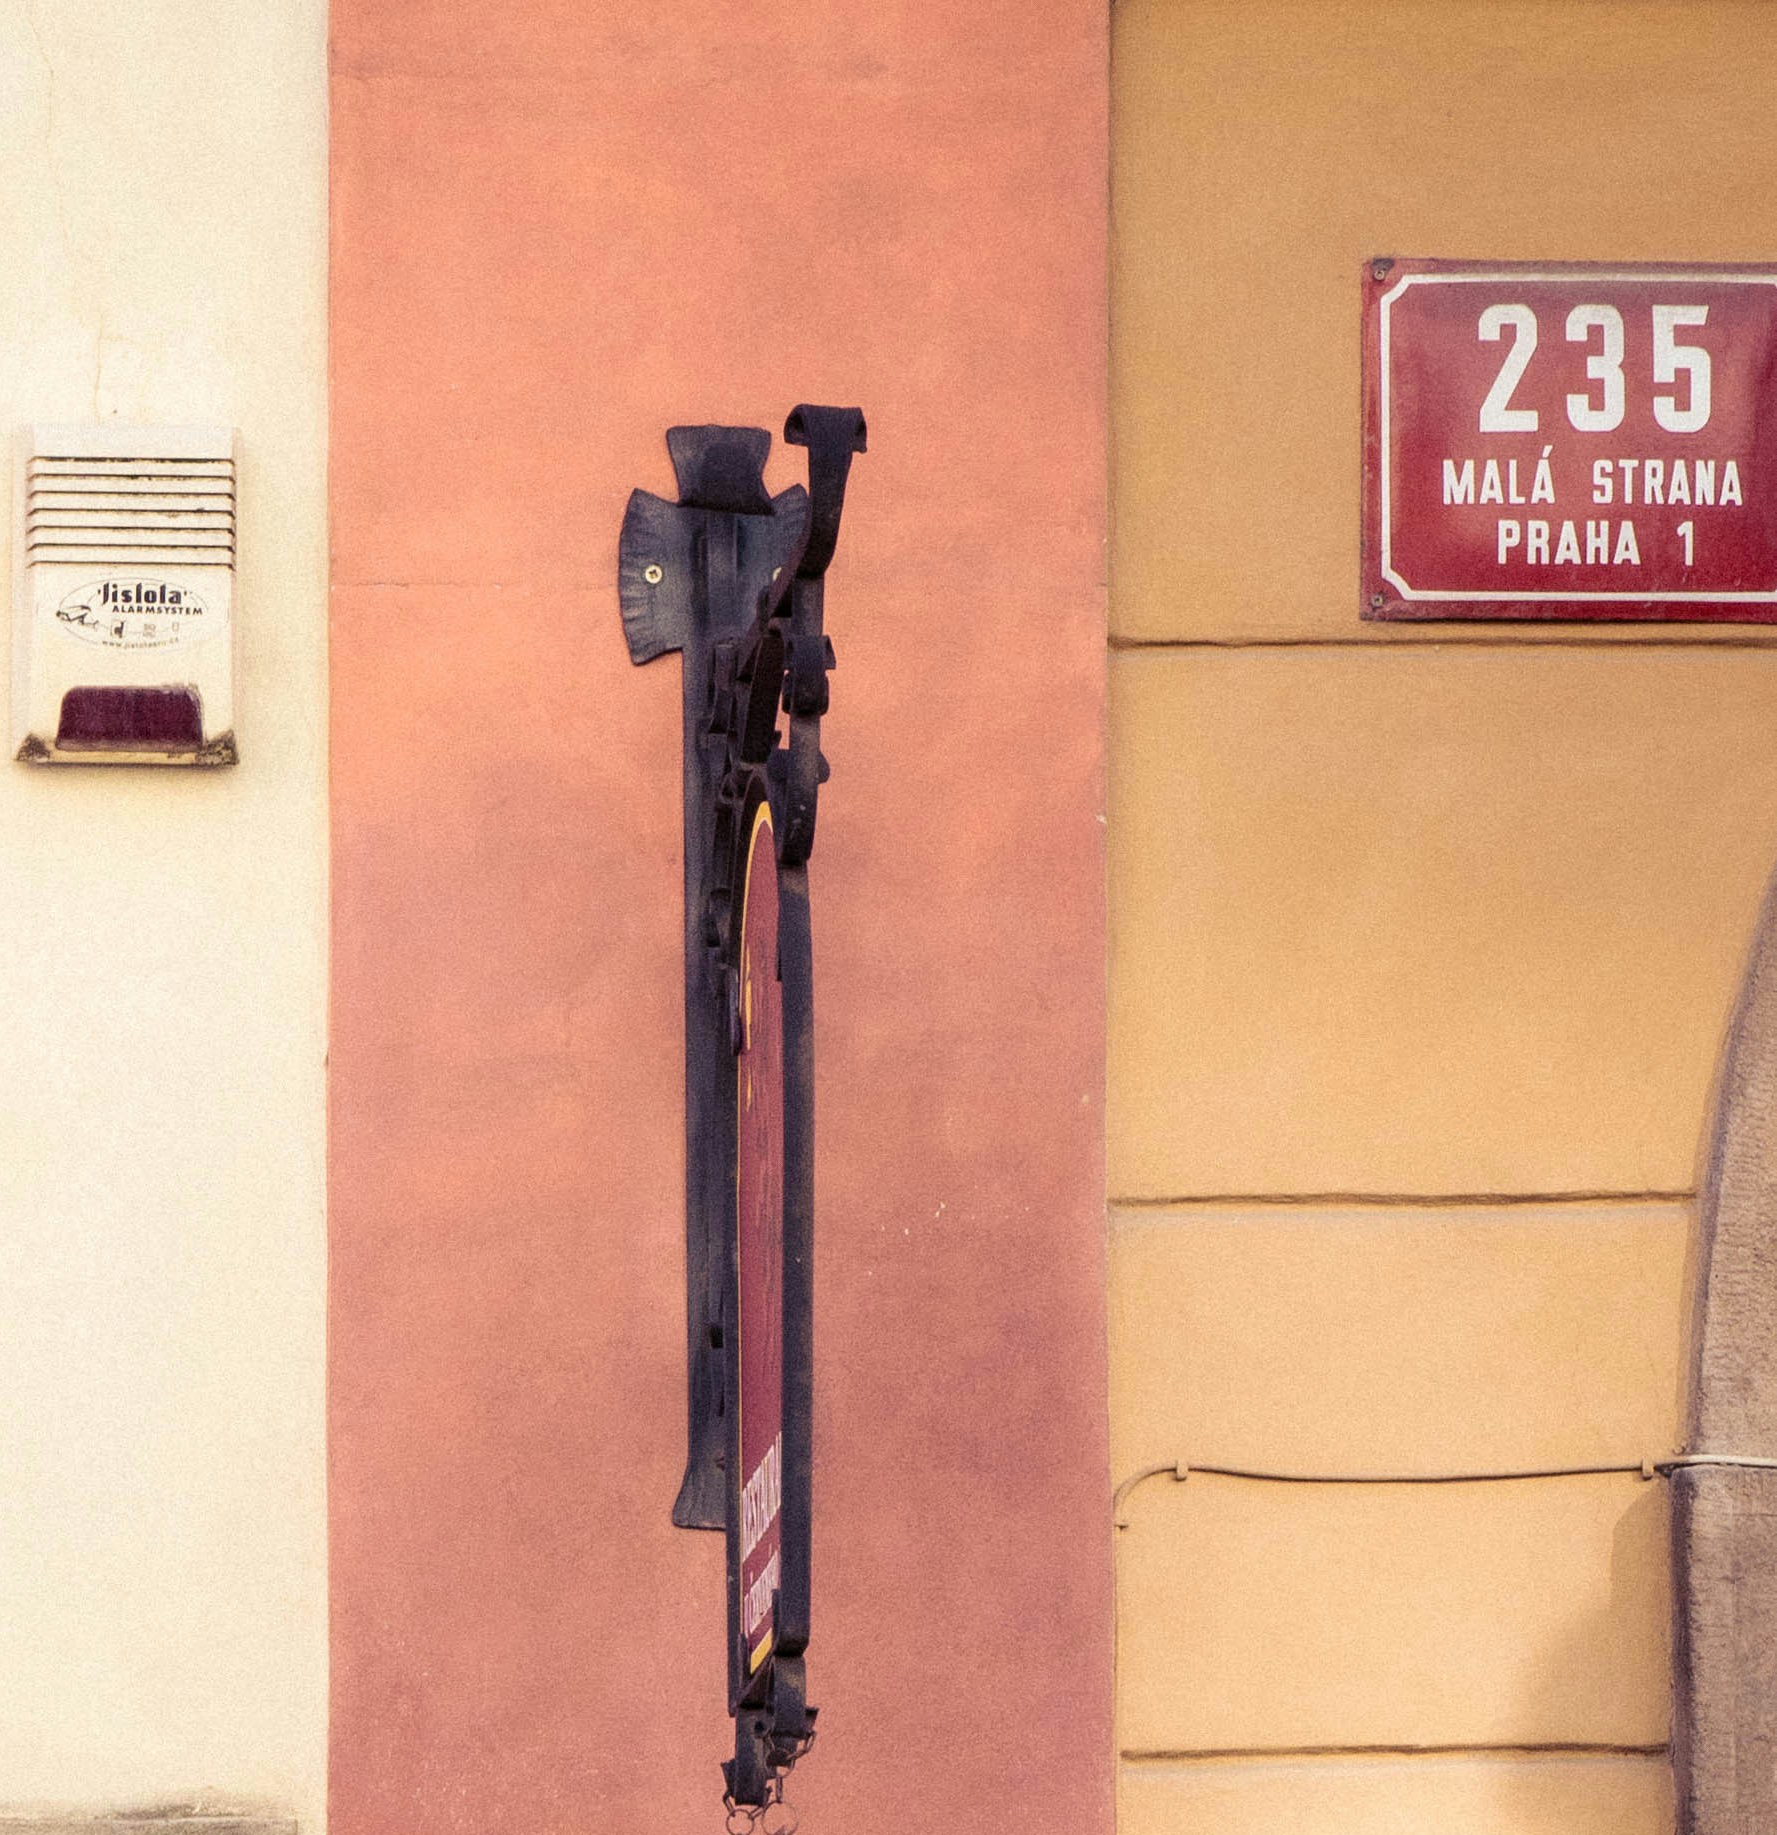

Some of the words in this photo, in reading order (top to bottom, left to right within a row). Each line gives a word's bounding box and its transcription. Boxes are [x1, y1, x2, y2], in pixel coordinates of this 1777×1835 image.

[1478, 304, 1712, 433] 235
[1441, 445, 1556, 506] MALÁ
[1591, 458, 1744, 507] STRANA
[1497, 519, 1642, 566] PRAHA
[1676, 519, 1695, 567] 1
[111, 604, 204, 616] ALARMSYSTEM
